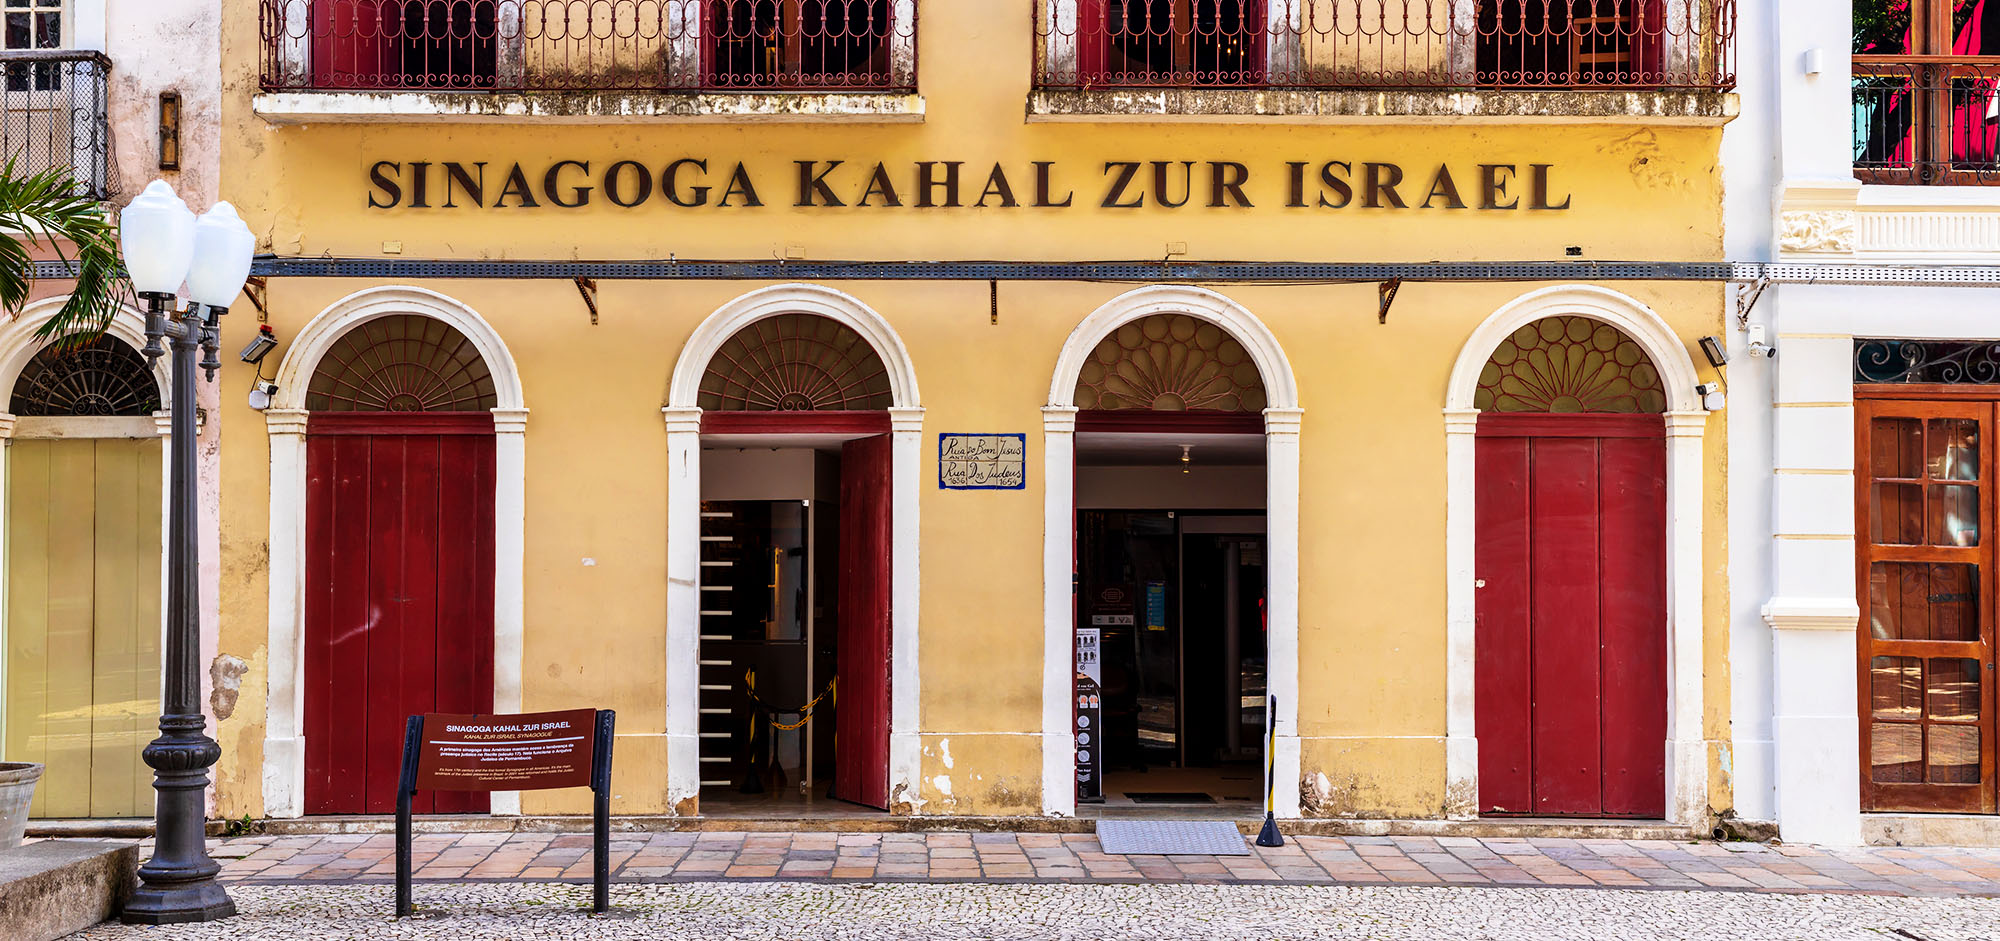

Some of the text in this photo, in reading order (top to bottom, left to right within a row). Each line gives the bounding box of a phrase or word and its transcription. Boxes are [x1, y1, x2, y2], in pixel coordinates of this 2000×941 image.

[368, 157, 1571, 210] SINAGOGA KAHAL ZUR ISRAEL
[942, 438, 966, 456] Rua
[972, 438, 996, 457] Bom
[943, 461, 1022, 484] Rua Dos Judeus
[948, 477, 966, 485] 1636
[999, 478, 1017, 486] 1654
[541, 721, 571, 730] ISRAEL
